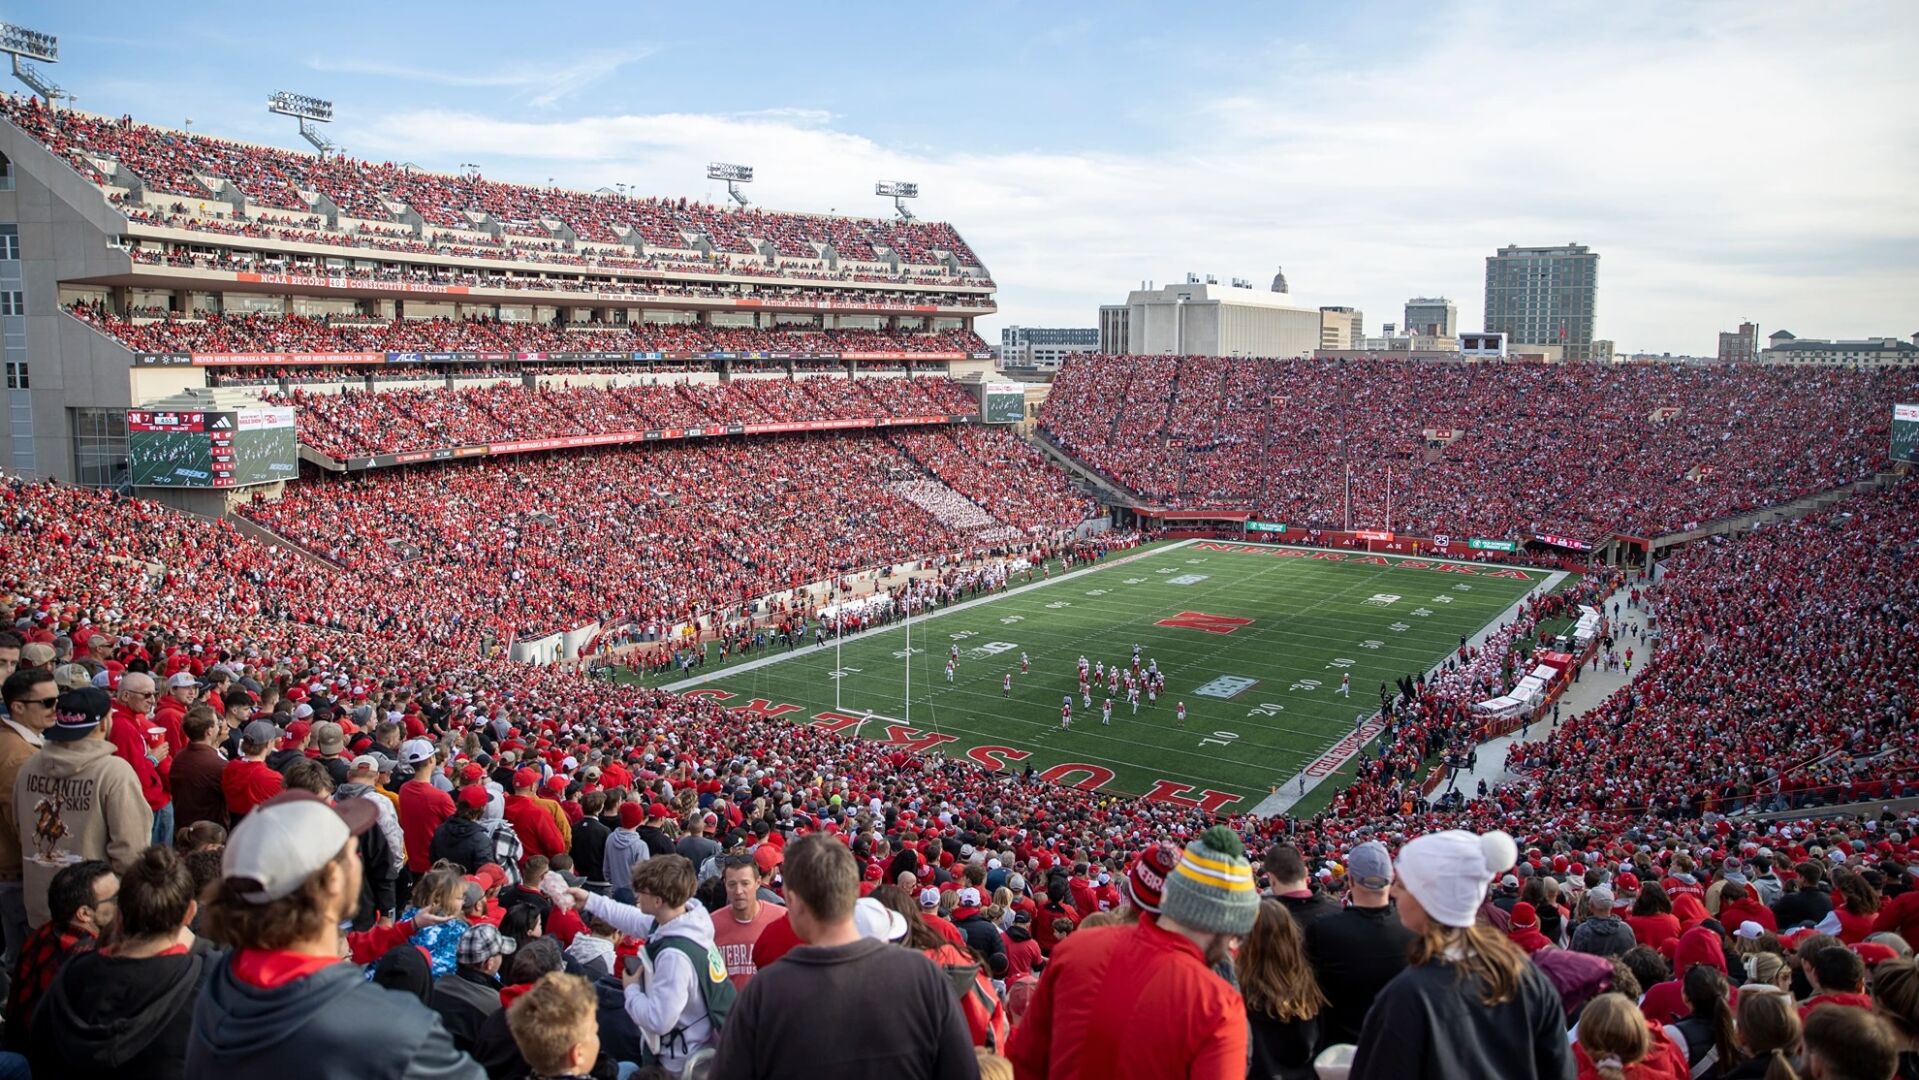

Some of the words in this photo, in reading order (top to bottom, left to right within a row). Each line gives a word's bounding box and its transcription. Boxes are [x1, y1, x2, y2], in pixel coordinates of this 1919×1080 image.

[205, 178, 215, 188] N
[302, 191, 312, 201] N
[261, 274, 287, 284] NCAA
[291, 276, 326, 287] RECORD
[350, 280, 407, 291] CONSECUTIVE
[410, 283, 448, 293] SELLOUTS
[833, 302, 865, 310] ACADEMIC
[397, 354, 416, 362] ACC
[132, 414, 141, 423] N
[1436, 536, 1447, 544] 25
[1192, 543, 1534, 580] NEBRASKA
[1153, 611, 1256, 635] N
[1290, 679, 1322, 692] 30
[1249, 703, 1284, 717] 20
[1202, 730, 1240, 747] 10
[1306, 755, 1344, 778] FIELD
[27, 774, 94, 797] ICELANTIC
[66, 798, 90, 811] SKIS
